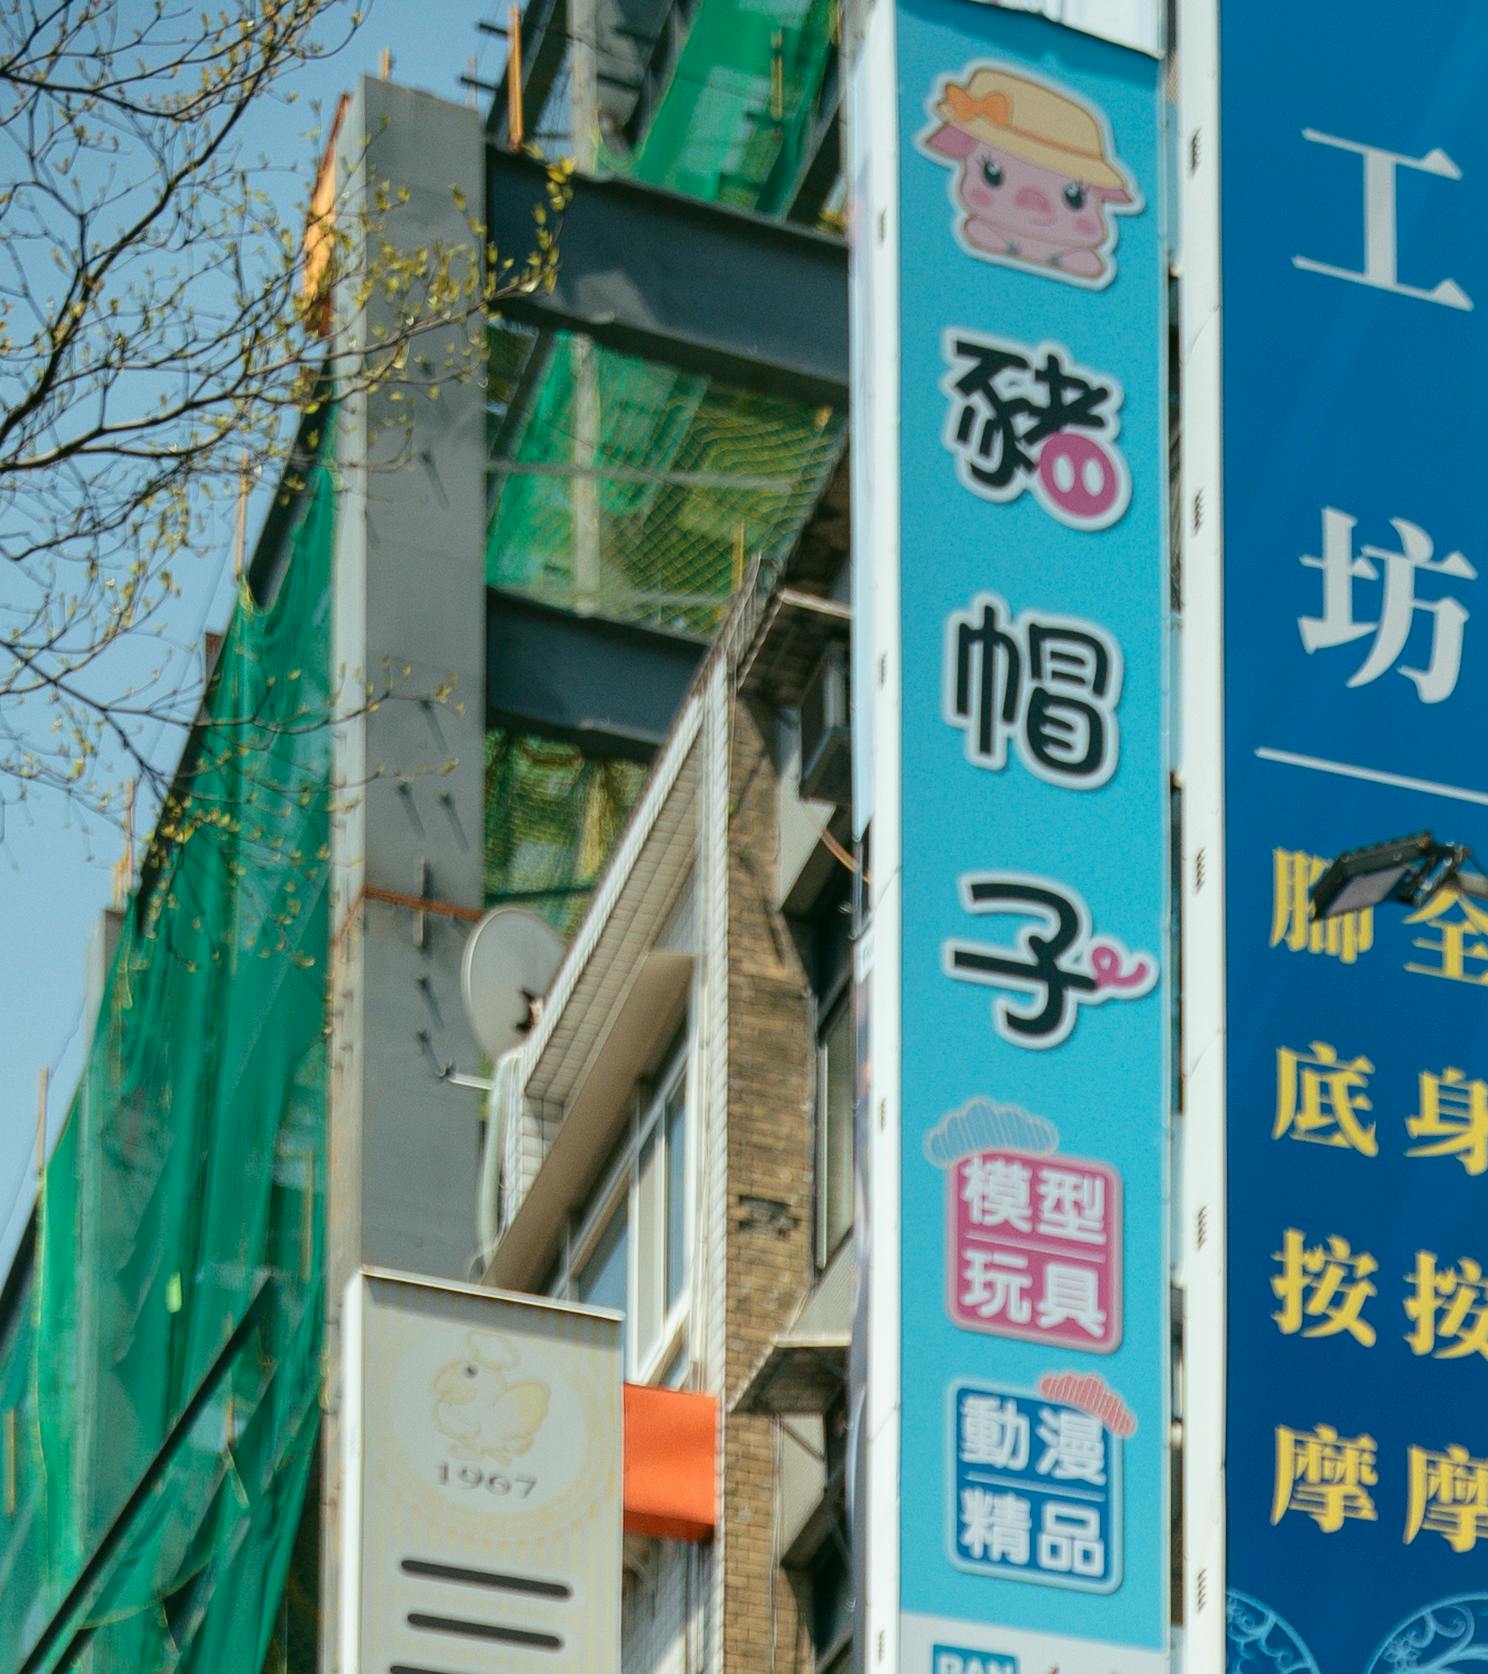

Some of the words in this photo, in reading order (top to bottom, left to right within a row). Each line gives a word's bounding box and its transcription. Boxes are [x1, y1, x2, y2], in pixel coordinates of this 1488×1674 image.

[1290, 125, 1478, 705] 工坊
[948, 335, 1150, 1045] 豬帽子
[960, 1155, 1109, 1244] 模型
[1269, 846, 1379, 1537] 腳底按摩
[960, 1247, 1109, 1342] 玩具
[437, 1461, 538, 1499] 1967
[960, 1388, 1110, 1486] 動漫
[960, 1482, 1110, 1581] 精品
